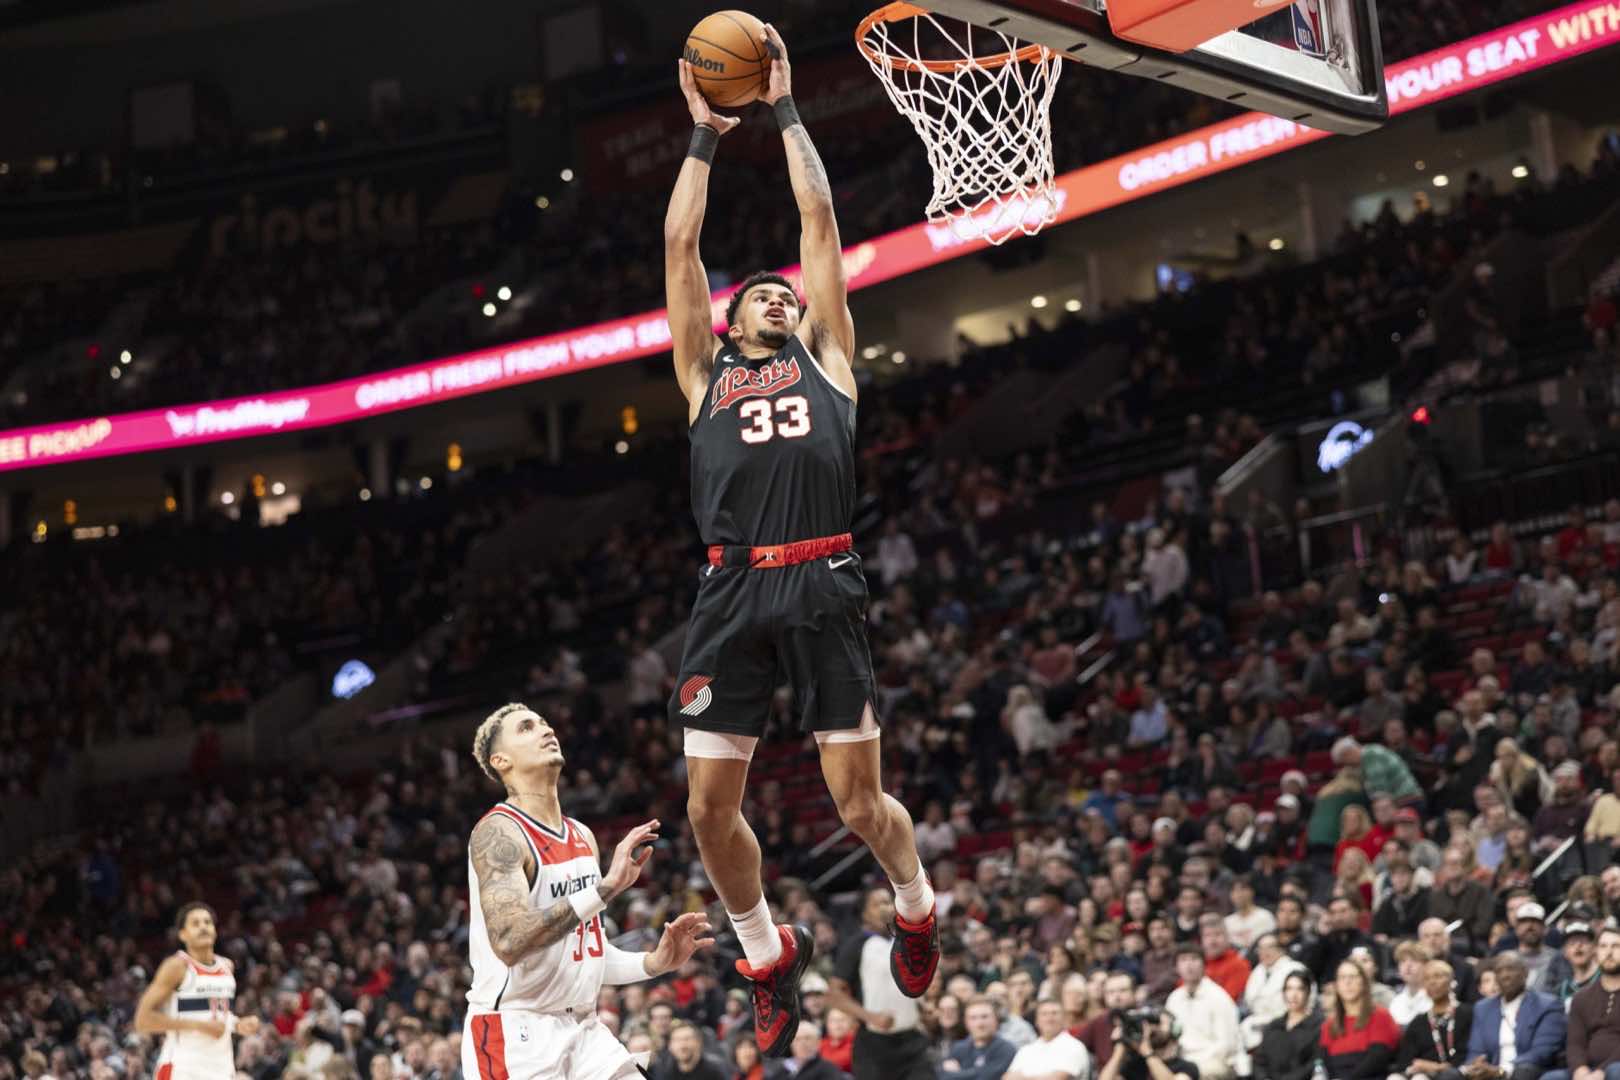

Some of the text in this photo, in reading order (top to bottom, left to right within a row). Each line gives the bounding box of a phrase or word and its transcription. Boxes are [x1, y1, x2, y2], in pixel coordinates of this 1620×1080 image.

[1298, 28, 1312, 47] NBA
[1385, 55, 1463, 102] YOUR
[1466, 28, 1541, 77] SEAT
[1119, 117, 1296, 191] ORDER FRESH
[356, 372, 431, 409] ORDER
[432, 355, 503, 392] FRESH
[29, 417, 112, 458] PICKUP
[738, 395, 812, 444] 33
